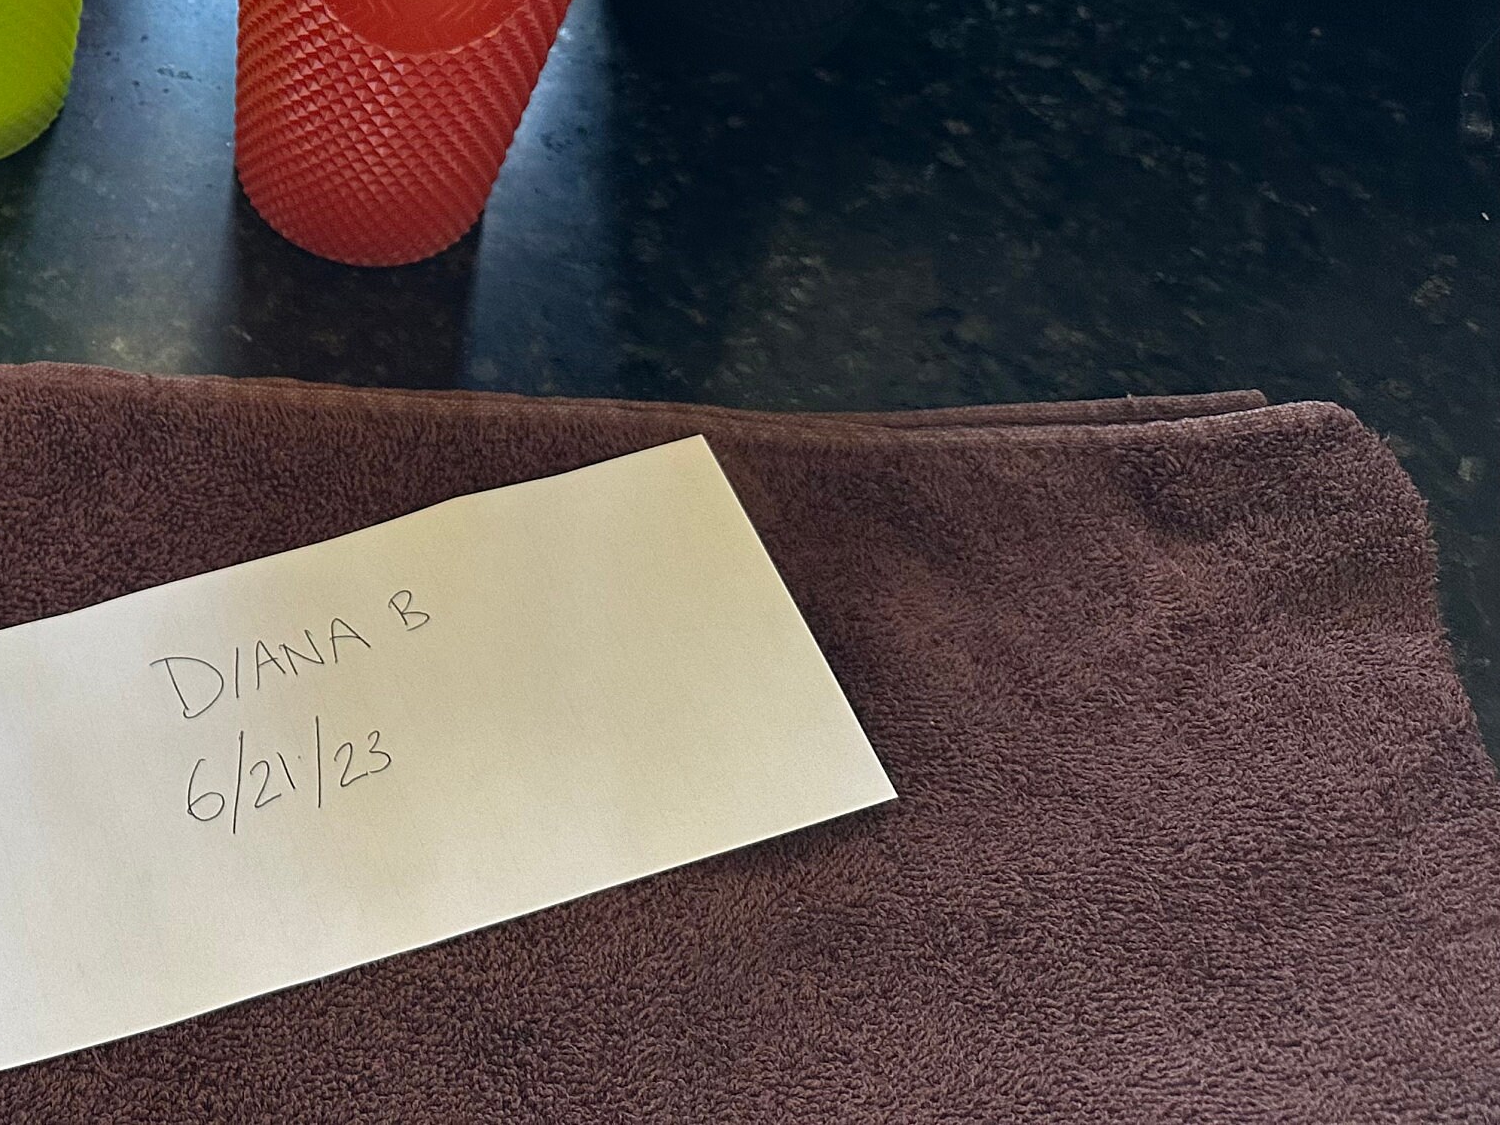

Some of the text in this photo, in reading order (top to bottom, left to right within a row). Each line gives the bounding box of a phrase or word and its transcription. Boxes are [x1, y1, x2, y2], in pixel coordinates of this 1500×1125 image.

[148, 589, 431, 719] DIANA B
[186, 715, 392, 835] 6/21/23
